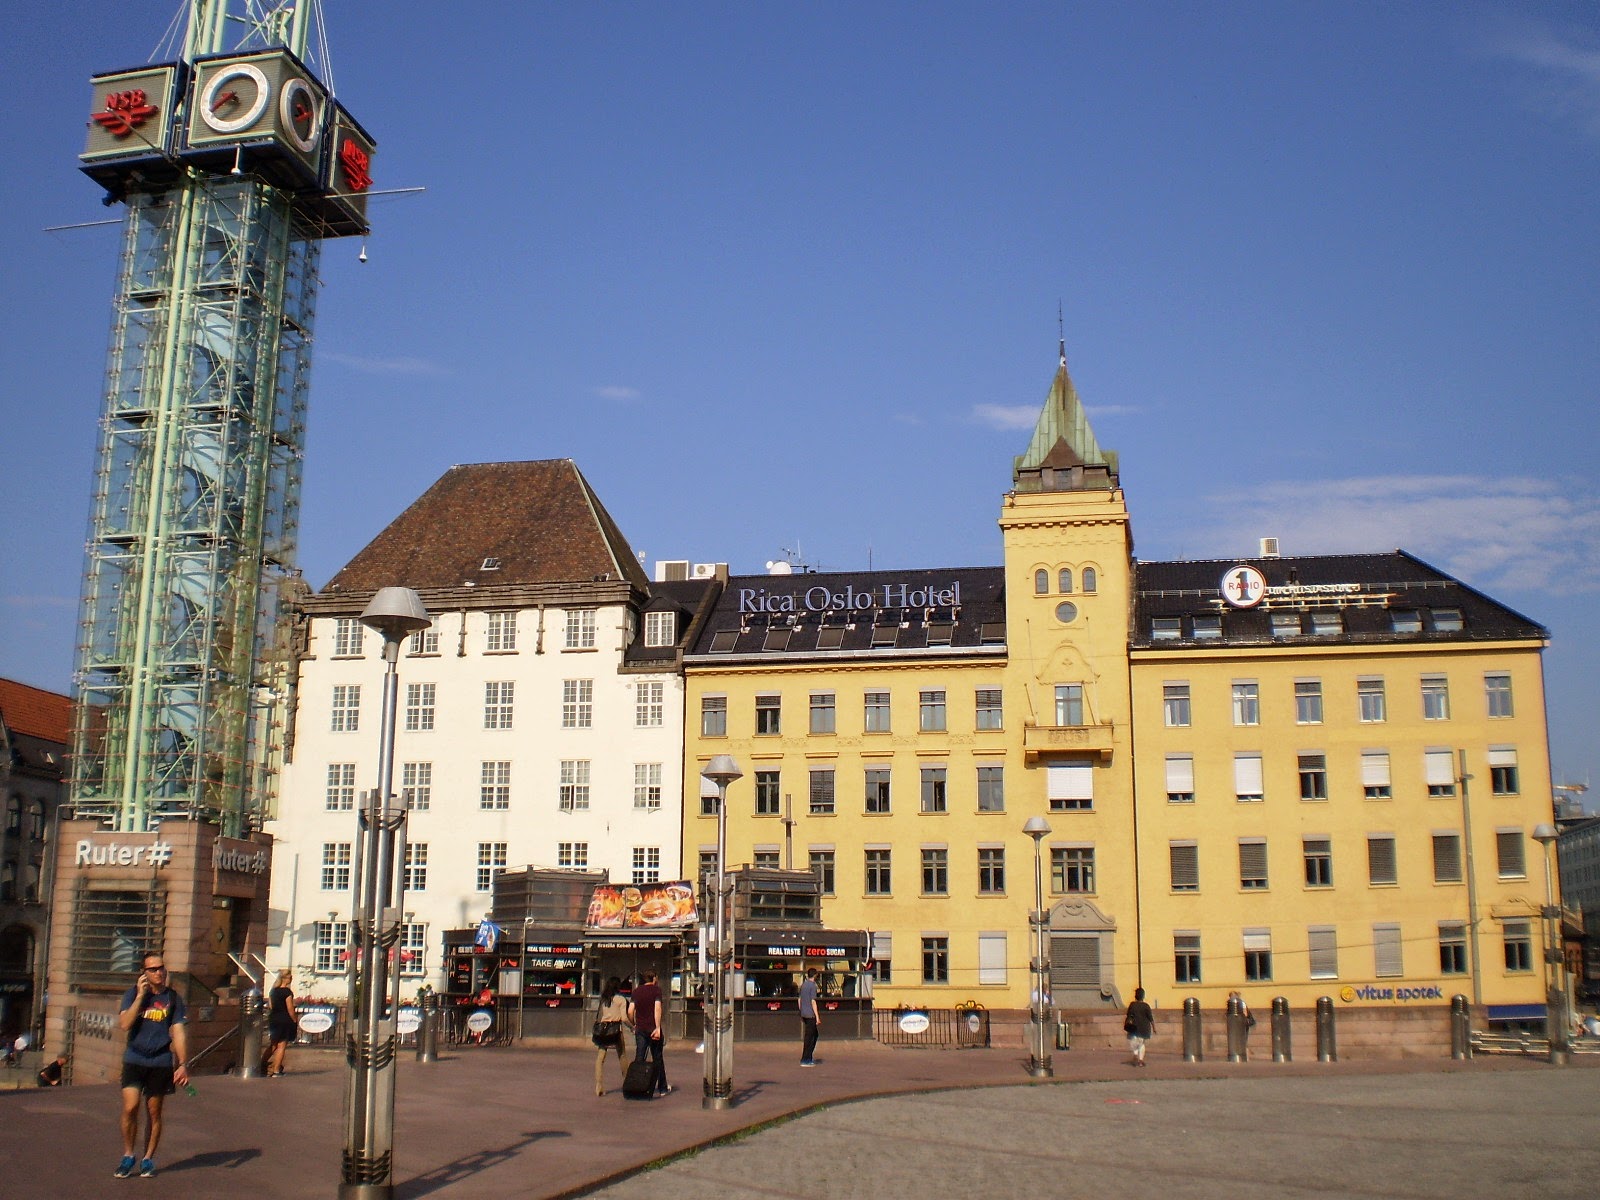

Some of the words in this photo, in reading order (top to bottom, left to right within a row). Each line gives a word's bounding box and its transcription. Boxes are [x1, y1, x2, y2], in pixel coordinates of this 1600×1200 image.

[105, 88, 146, 109] NSB
[1228, 581, 1260, 590] RADIO
[738, 588, 795, 613] Rica
[805, 584, 873, 612] Oslo
[882, 580, 962, 609] Hotel
[75, 839, 171, 867] Ruter#
[211, 844, 268, 874] Ruter#
[538, 945, 552, 953] TASTE
[552, 946, 568, 954] zero
[768, 947, 783, 956] REAL
[783, 947, 801, 956] TASTE
[806, 947, 826, 956] zero
[826, 947, 846, 956] SUGAR
[531, 959, 552, 968] TAKE
[1355, 985, 1394, 1000] vitus
[1396, 986, 1443, 1003] apotek
